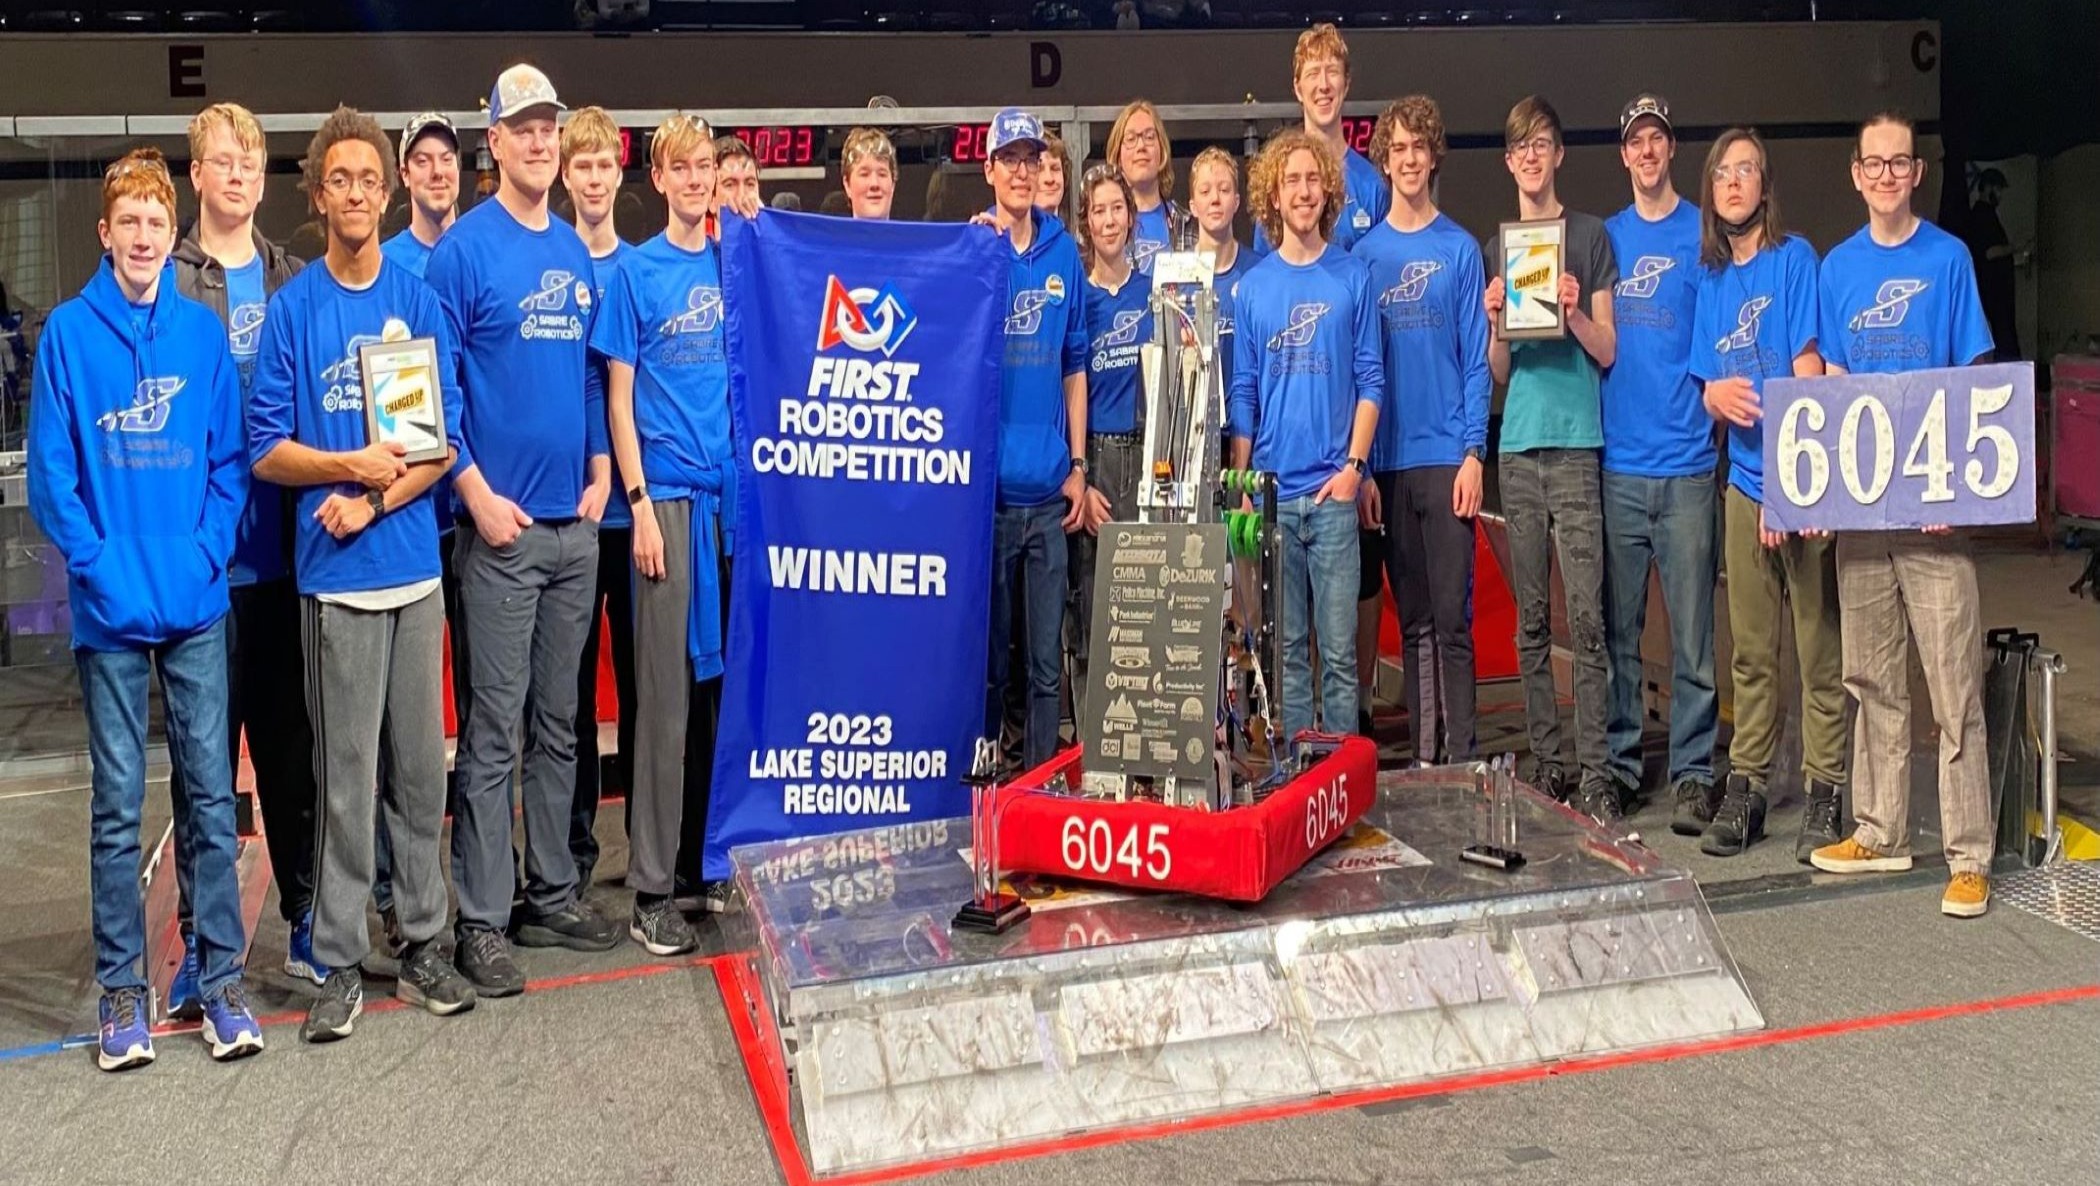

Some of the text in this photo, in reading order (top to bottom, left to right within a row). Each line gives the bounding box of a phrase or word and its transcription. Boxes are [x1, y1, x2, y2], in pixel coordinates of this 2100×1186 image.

[169, 45, 206, 97] E
[1030, 42, 1061, 88] D
[1911, 30, 1936, 71] C
[534, 328, 575, 339] ROBOTICS
[539, 315, 568, 326] SABRE
[807, 357, 920, 402] FIRST
[780, 398, 944, 443] ROBOTICS
[752, 437, 971, 485] COMPETITION
[1777, 384, 2019, 506] 6045
[768, 545, 947, 597] WINNER
[807, 712, 892, 746] 2023
[750, 749, 947, 780] LAKE SUPERIOR
[784, 784, 910, 815] REGIONAL
[1306, 772, 1348, 849] 6045
[1061, 815, 1171, 880] 6045
